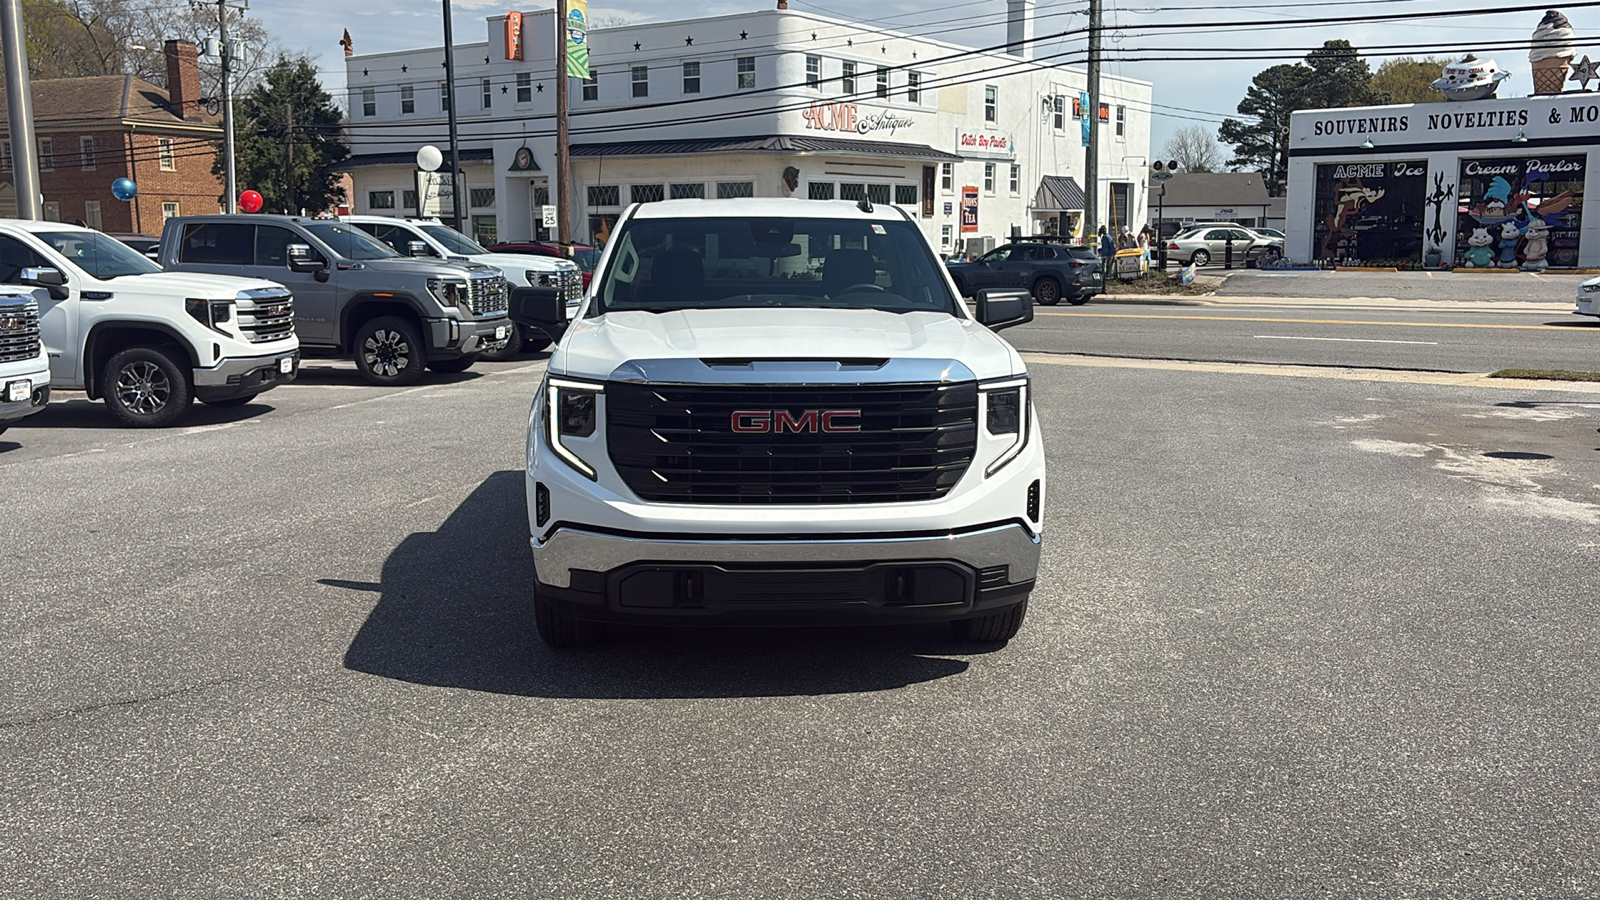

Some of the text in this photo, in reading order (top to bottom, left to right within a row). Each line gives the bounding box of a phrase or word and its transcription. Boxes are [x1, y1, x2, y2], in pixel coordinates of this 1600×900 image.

[512, 15, 520, 57] ACME
[802, 100, 857, 133] ACME
[859, 109, 914, 136] Antiques
[1314, 105, 1599, 136] SOUVENIRS NOVELTIES & MO
[961, 133, 1007, 150] Dutch Boy Paints
[1334, 159, 1583, 178] ACME Ice Cream Parlor
[545, 216, 556, 225] 25
[965, 212, 976, 223] TEA
[731, 409, 861, 433] GMC
